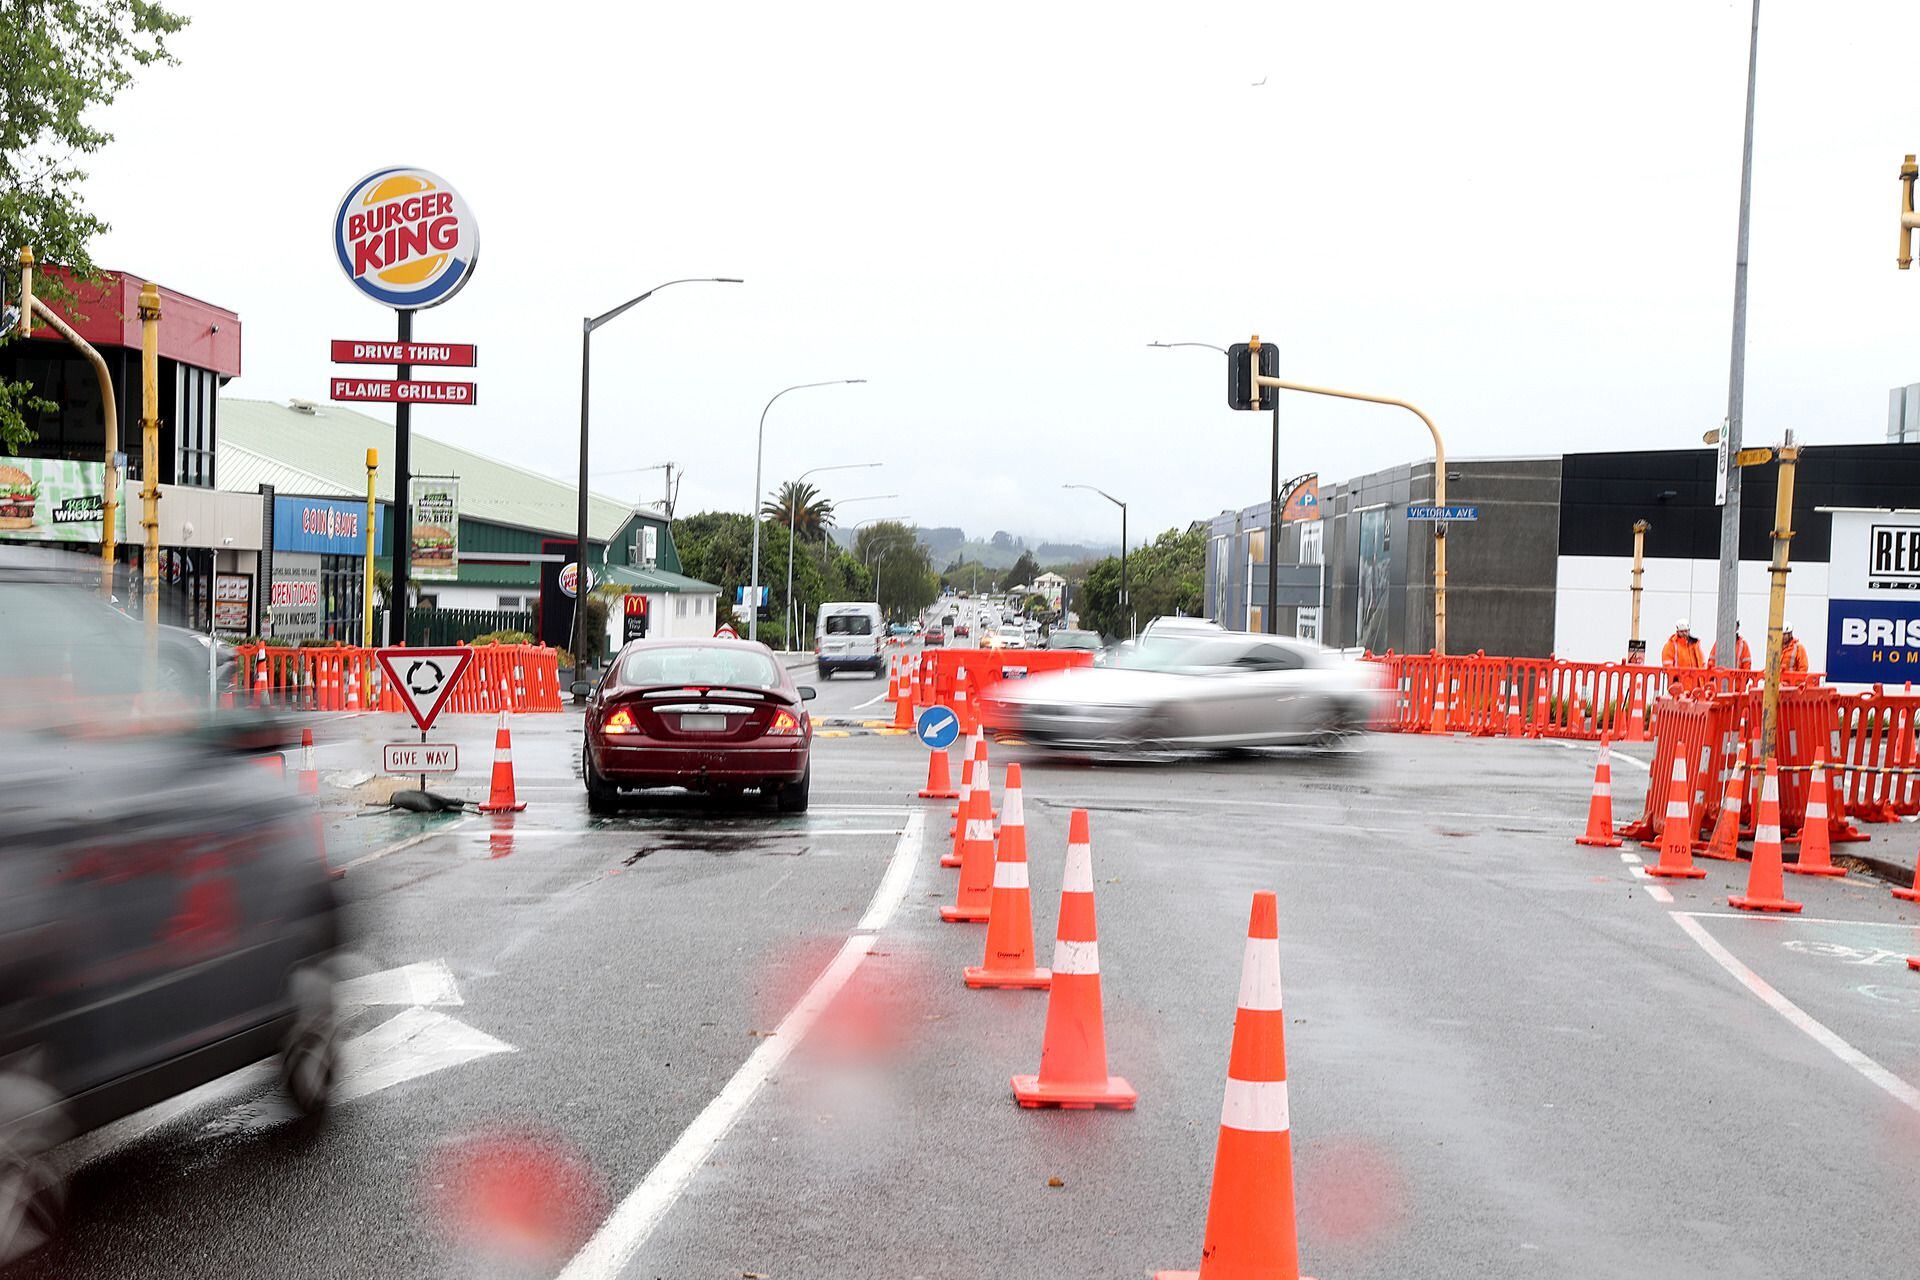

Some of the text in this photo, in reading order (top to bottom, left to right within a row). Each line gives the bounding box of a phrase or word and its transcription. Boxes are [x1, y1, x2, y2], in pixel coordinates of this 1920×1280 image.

[348, 192, 453, 241] BURGER
[355, 216, 459, 277] KING
[353, 345, 450, 361] DRIVE THRU
[335, 382, 467, 400] FLAME GRILLED
[1304, 494, 1313, 507] P
[55, 509, 103, 521] WHOPPE
[418, 514, 452, 522] 0% BEEF
[1410, 507, 1475, 518] VICTORIA AVE
[302, 507, 358, 538] COIN SAVE
[1876, 531, 1920, 571] REB
[1872, 582, 1917, 590] SPO
[271, 582, 318, 608] OPEN 7 DAYS
[1842, 617, 1920, 648] BRIS
[1872, 650, 1919, 664] HOM
[392, 751, 449, 765] GIVE WAY
